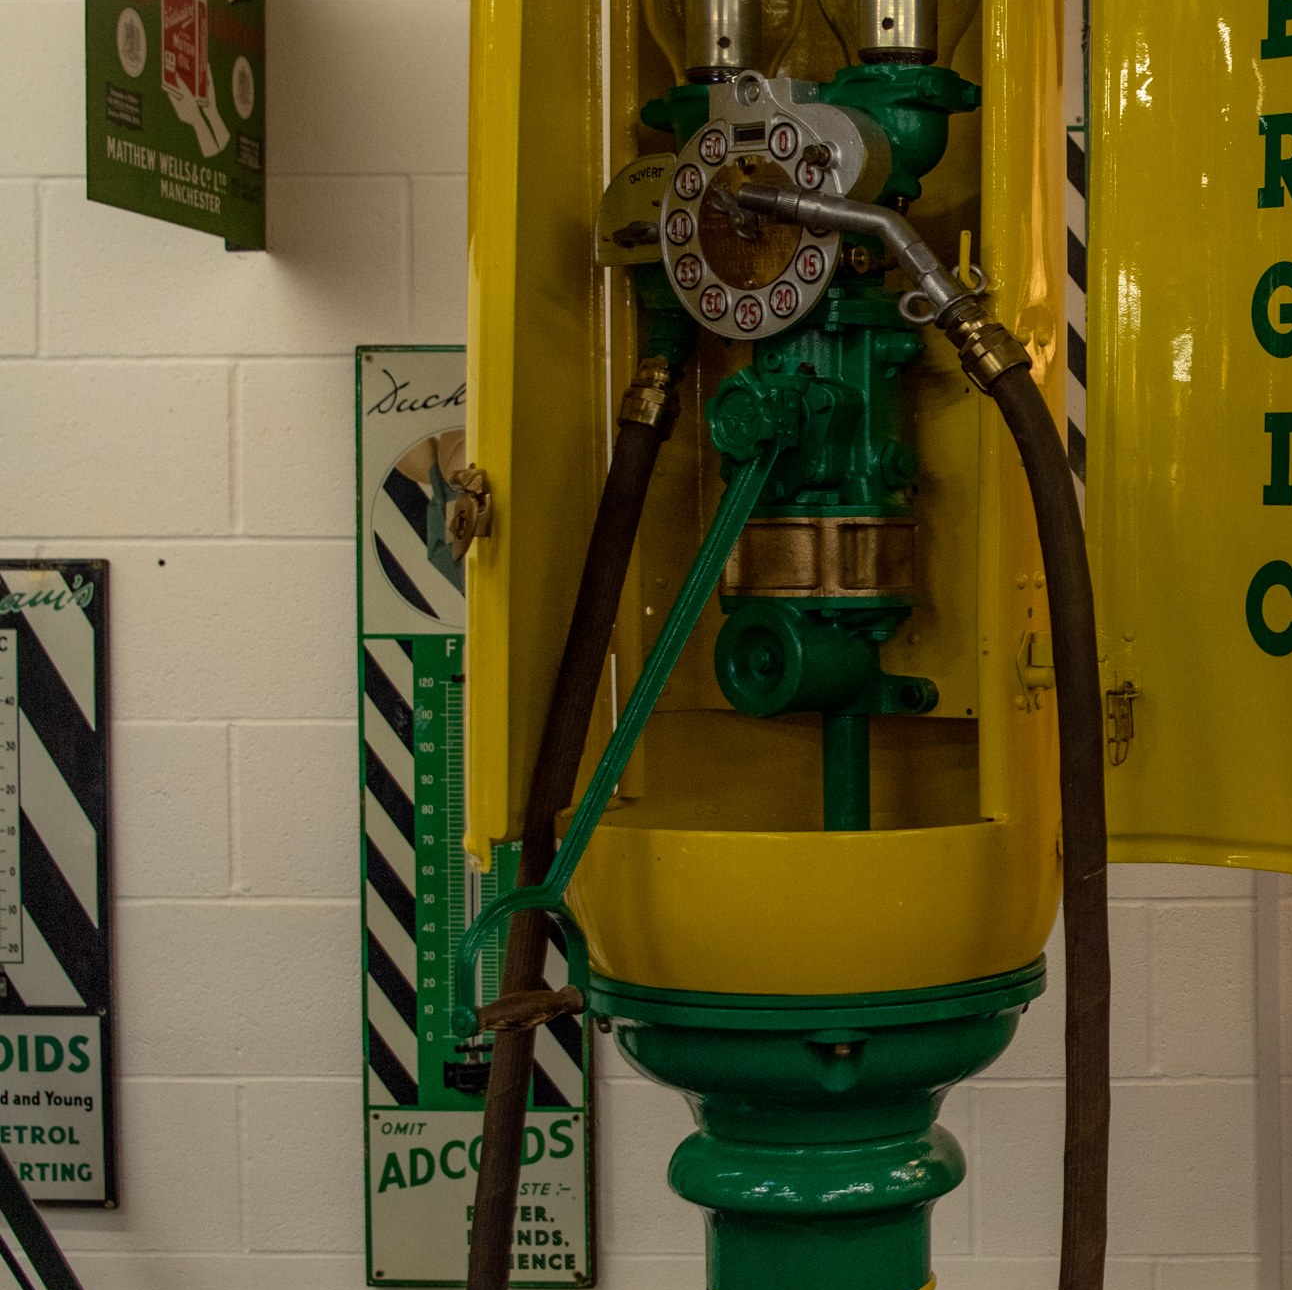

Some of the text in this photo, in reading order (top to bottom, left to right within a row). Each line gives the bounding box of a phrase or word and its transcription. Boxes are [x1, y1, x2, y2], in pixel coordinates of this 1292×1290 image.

[778, 130, 790, 153] 0
[107, 135, 157, 172] MATTHEW
[628, 166, 665, 185] OUVERT
[160, 179, 221, 215] MANCHESTER
[803, 254, 817, 277] 15
[775, 288, 793, 311] 20
[740, 302, 758, 325] 25
[446, 638, 457, 657] F
[418, 677, 434, 688] 120
[420, 709, 433, 720] 110
[419, 742, 434, 753] 100
[420, 774, 434, 785] 90
[420, 804, 434, 815] 80
[421, 835, 435, 846] 70
[421, 865, 435, 876] 60
[422, 894, 435, 904] 50
[422, 922, 436, 932] 40
[422, 951, 436, 961] 30
[422, 978, 436, 988] 20
[423, 1005, 434, 1015] 10
[426, 1032, 433, 1042] 0
[13, 1090, 41, 1107] and
[45, 1090, 94, 1113] Young
[381, 1122, 428, 1136] OMIT
[19, 1162, 92, 1182] RTING
